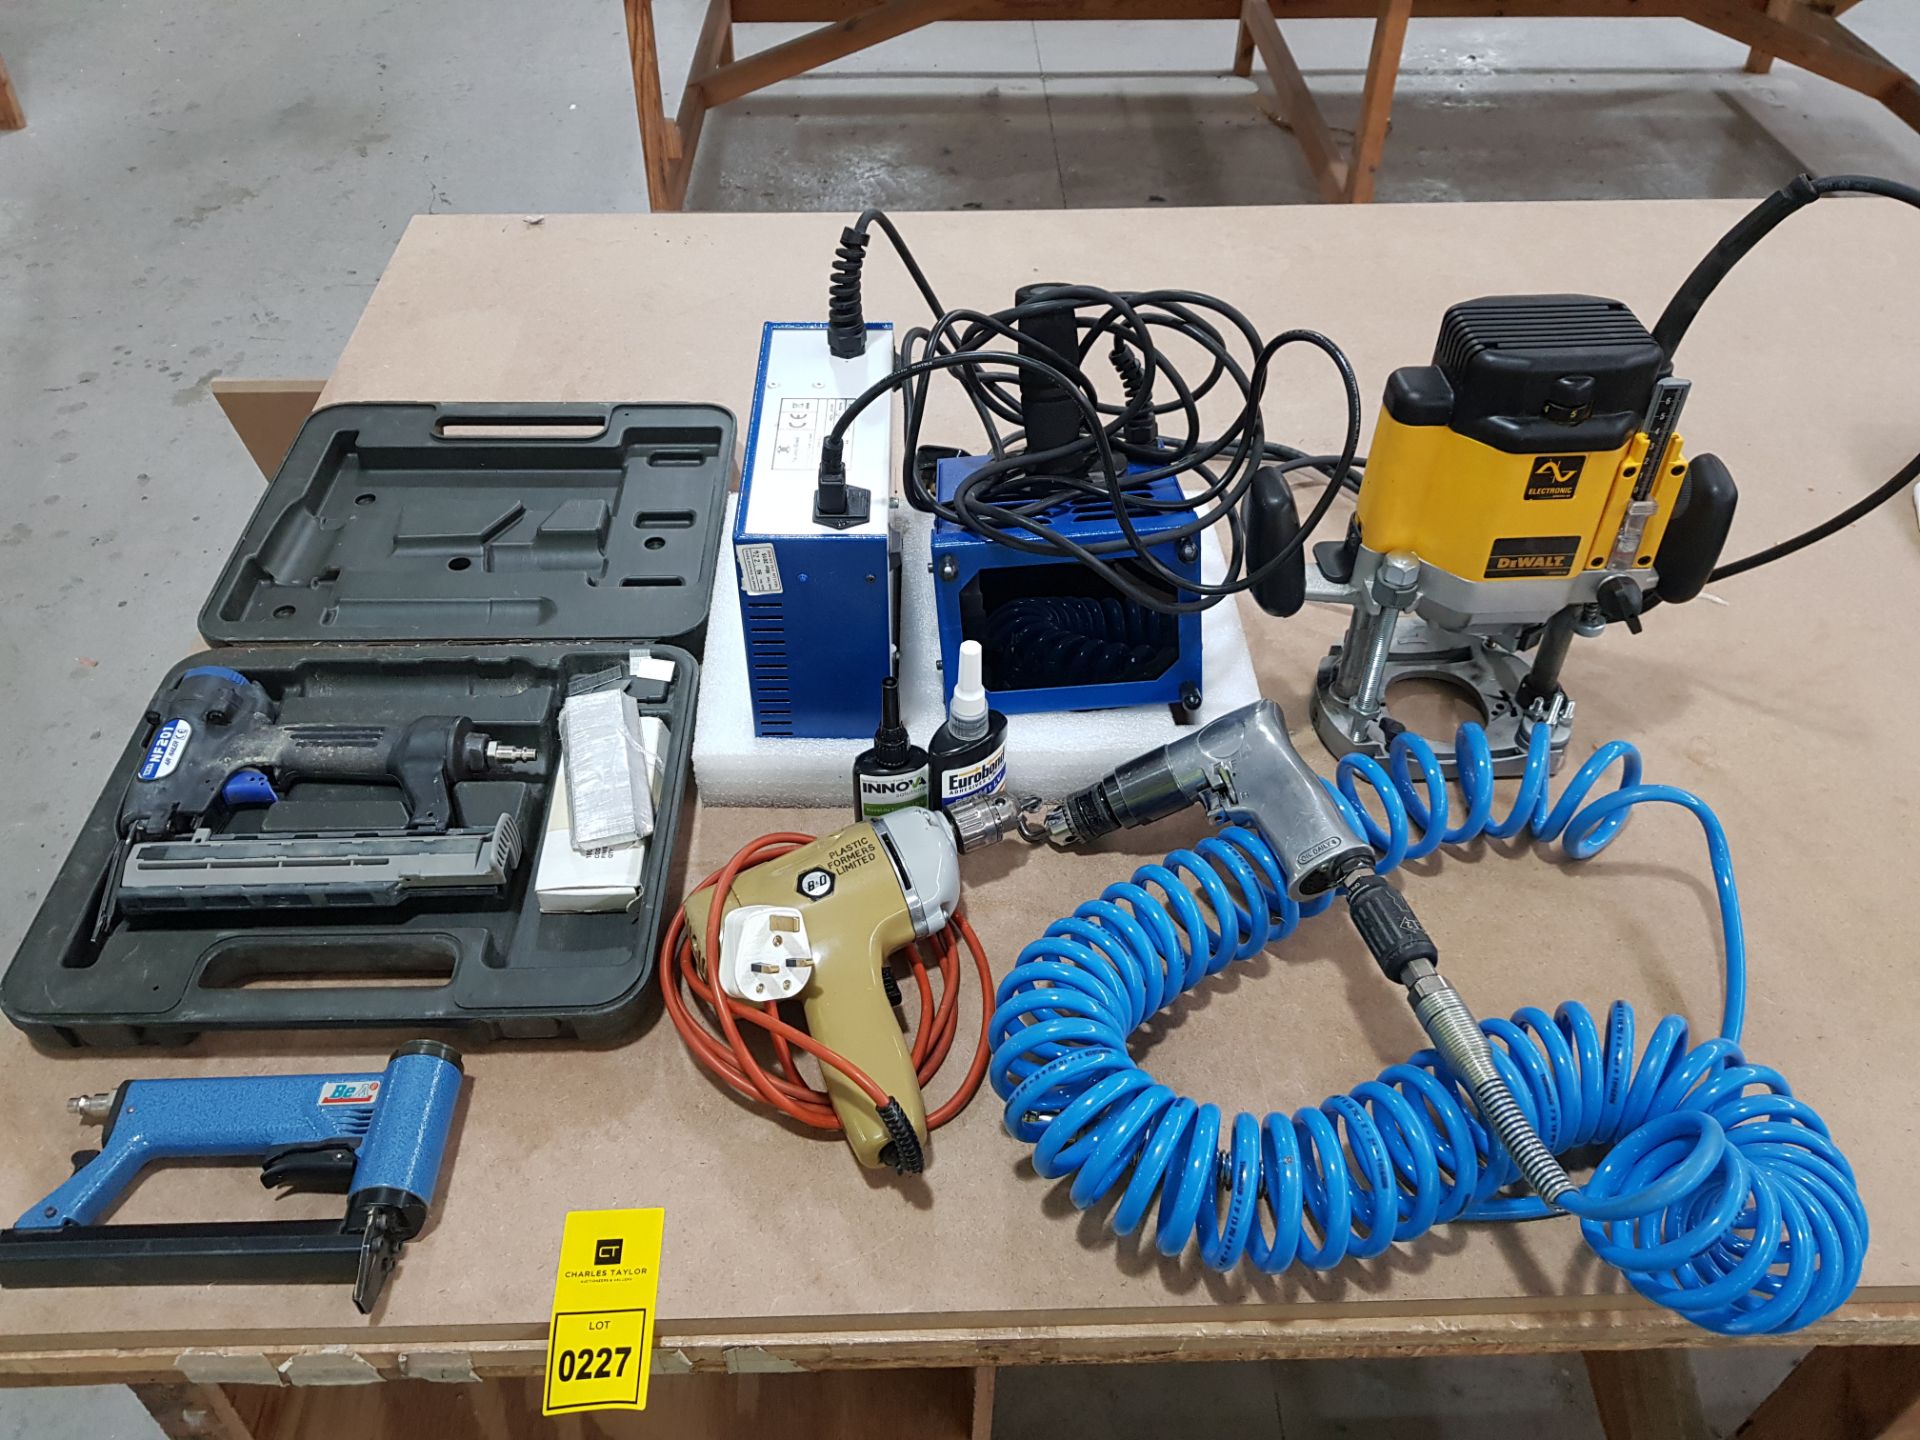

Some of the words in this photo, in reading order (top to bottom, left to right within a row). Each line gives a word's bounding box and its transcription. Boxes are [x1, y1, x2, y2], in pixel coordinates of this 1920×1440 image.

[1528, 487, 1573, 495] ELECTRONIC
[149, 727, 174, 763] NF201
[949, 745, 1005, 790] Eurobond
[863, 776, 927, 794] INNOVA
[827, 844, 876, 870] FORMERS
[828, 837, 869, 859] PLASTIC
[836, 853, 876, 876] LIMITED
[565, 1269, 607, 1278] CHARLES
[611, 1268, 648, 1277] TAYLOR
[589, 1321, 611, 1331] LOT
[558, 1347, 632, 1382] 0227
